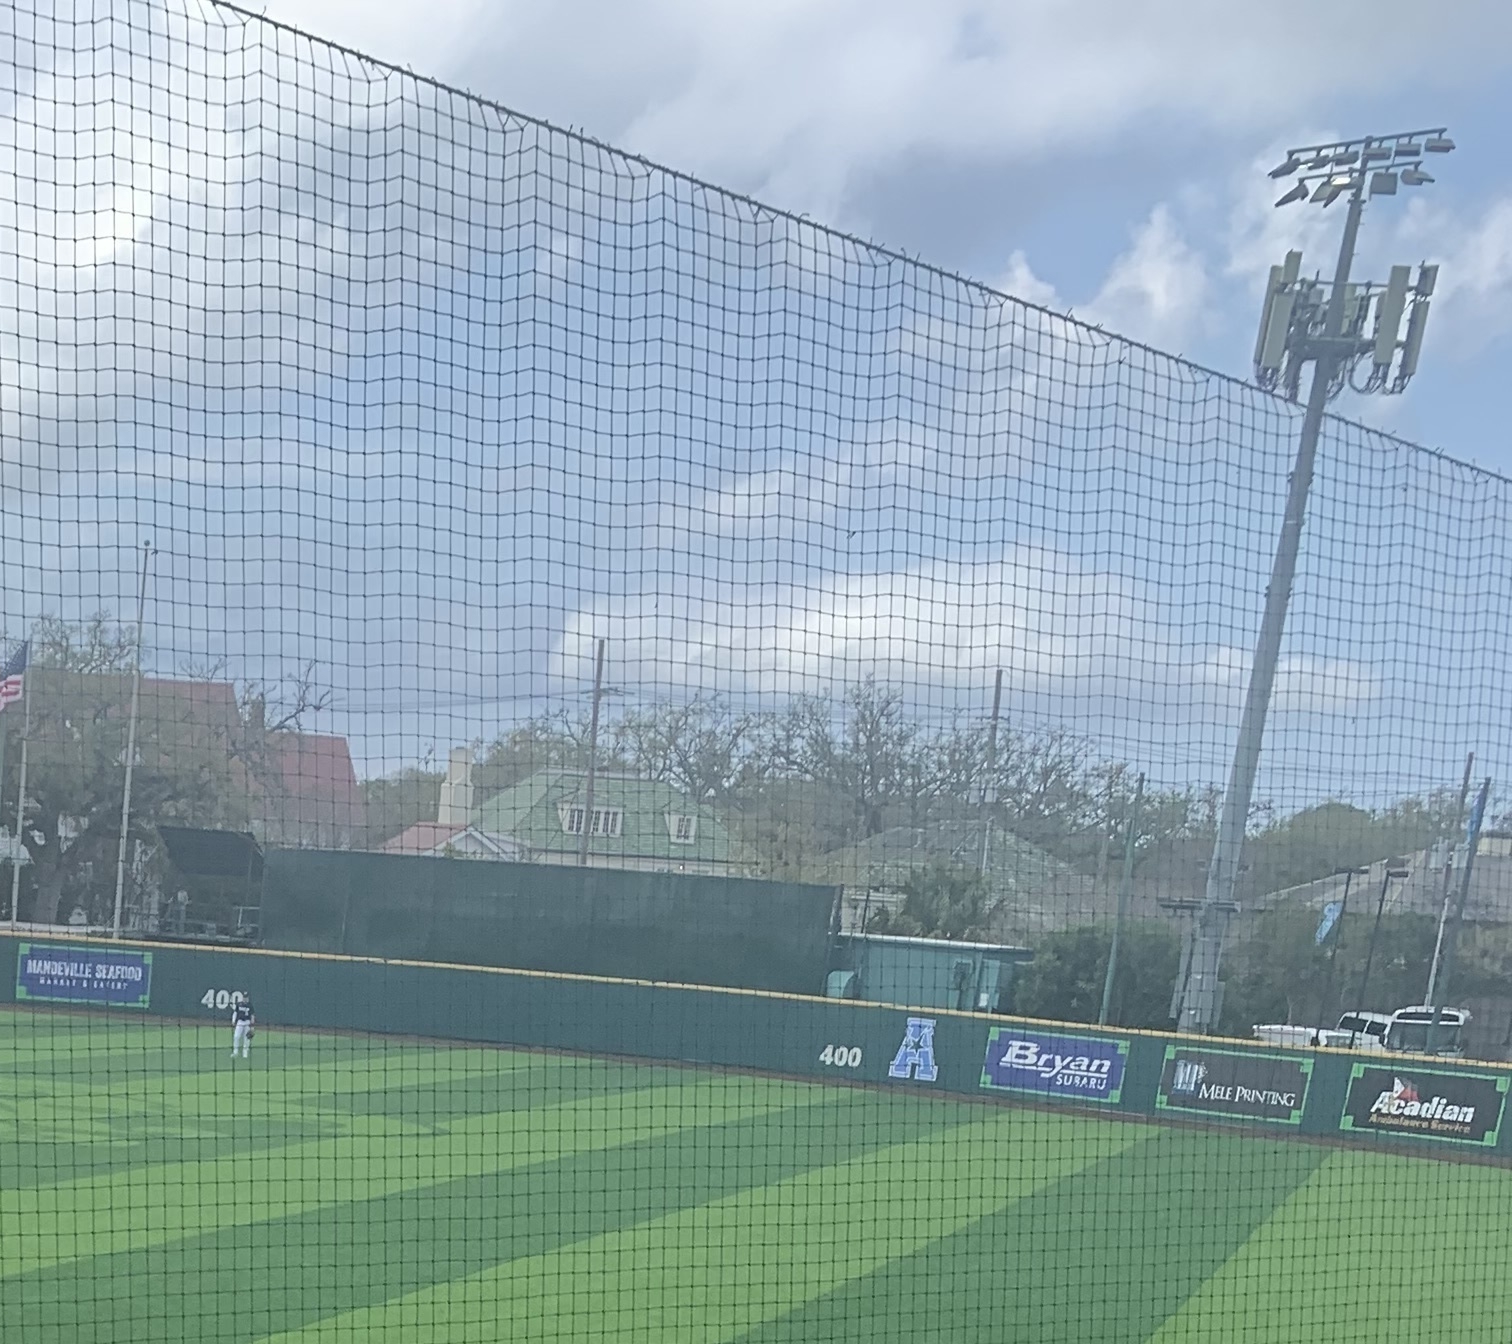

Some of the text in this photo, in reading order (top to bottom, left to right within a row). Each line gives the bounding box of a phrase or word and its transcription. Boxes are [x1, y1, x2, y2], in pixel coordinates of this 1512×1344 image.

[27, 959, 143, 982] MANDEVILLE SEAFOOD
[200, 988, 244, 1010] 400
[818, 1044, 863, 1068] 400
[1000, 1040, 1111, 1078] Bryan
[1055, 1073, 1108, 1091] SUBARU
[1198, 1082, 1296, 1108] MELE PRINTING
[1369, 1091, 1475, 1124] Acadian
[1369, 1113, 1471, 1134] Ambulance Service
